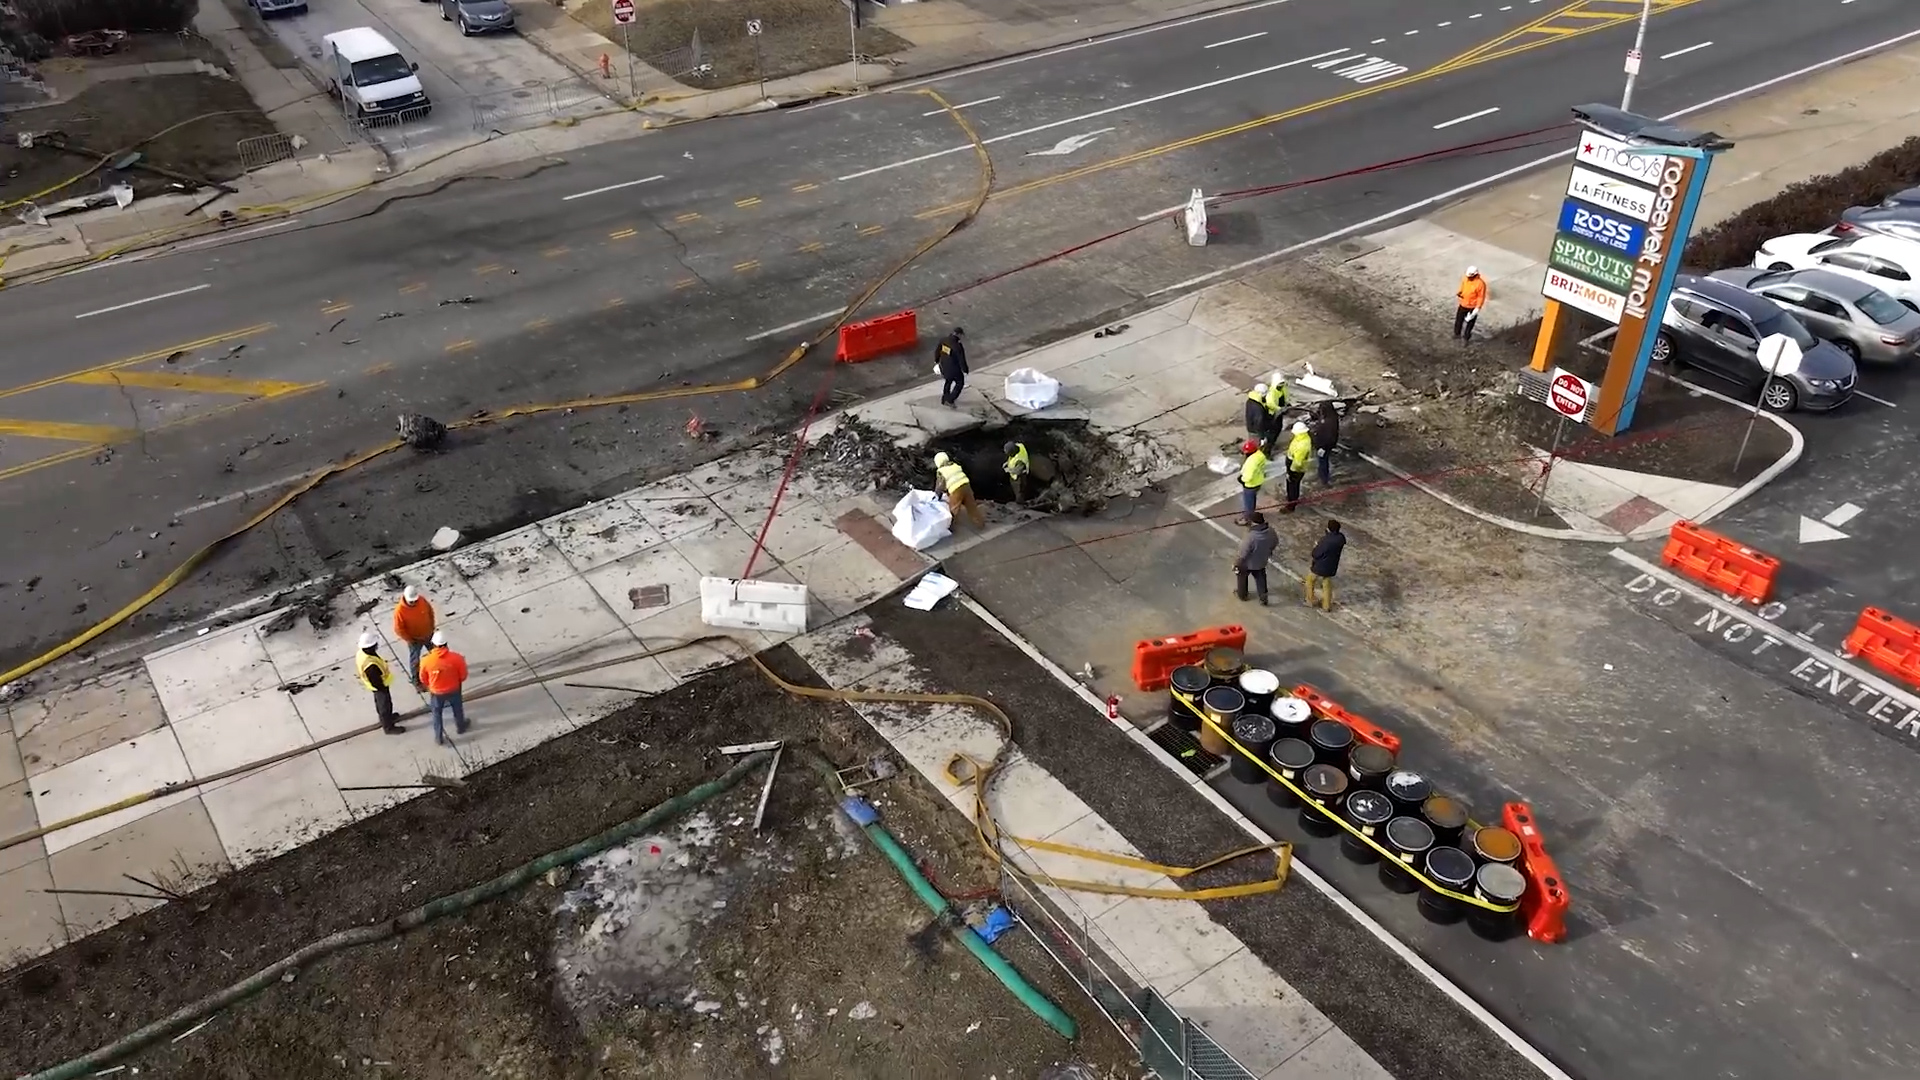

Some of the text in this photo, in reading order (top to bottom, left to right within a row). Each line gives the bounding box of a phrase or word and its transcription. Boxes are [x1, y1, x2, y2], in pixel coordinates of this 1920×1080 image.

[1312, 53, 1409, 83] ONLY
[1596, 145, 1662, 177] macy's
[1574, 181, 1647, 214] LA FITNESS
[1573, 208, 1633, 242] ROSS
[1594, 233, 1610, 244] FOR
[1625, 157, 1685, 320] roosevelt mall
[1554, 239, 1633, 280] SPROUTS
[1556, 254, 1626, 287] FARMERS MARKET
[1550, 274, 1618, 310] BRIXMOR
[1556, 395, 1578, 411] ENTER
[1558, 377, 1584, 396] DO NOT
[1624, 573, 1920, 738] DO NOT ENTER
